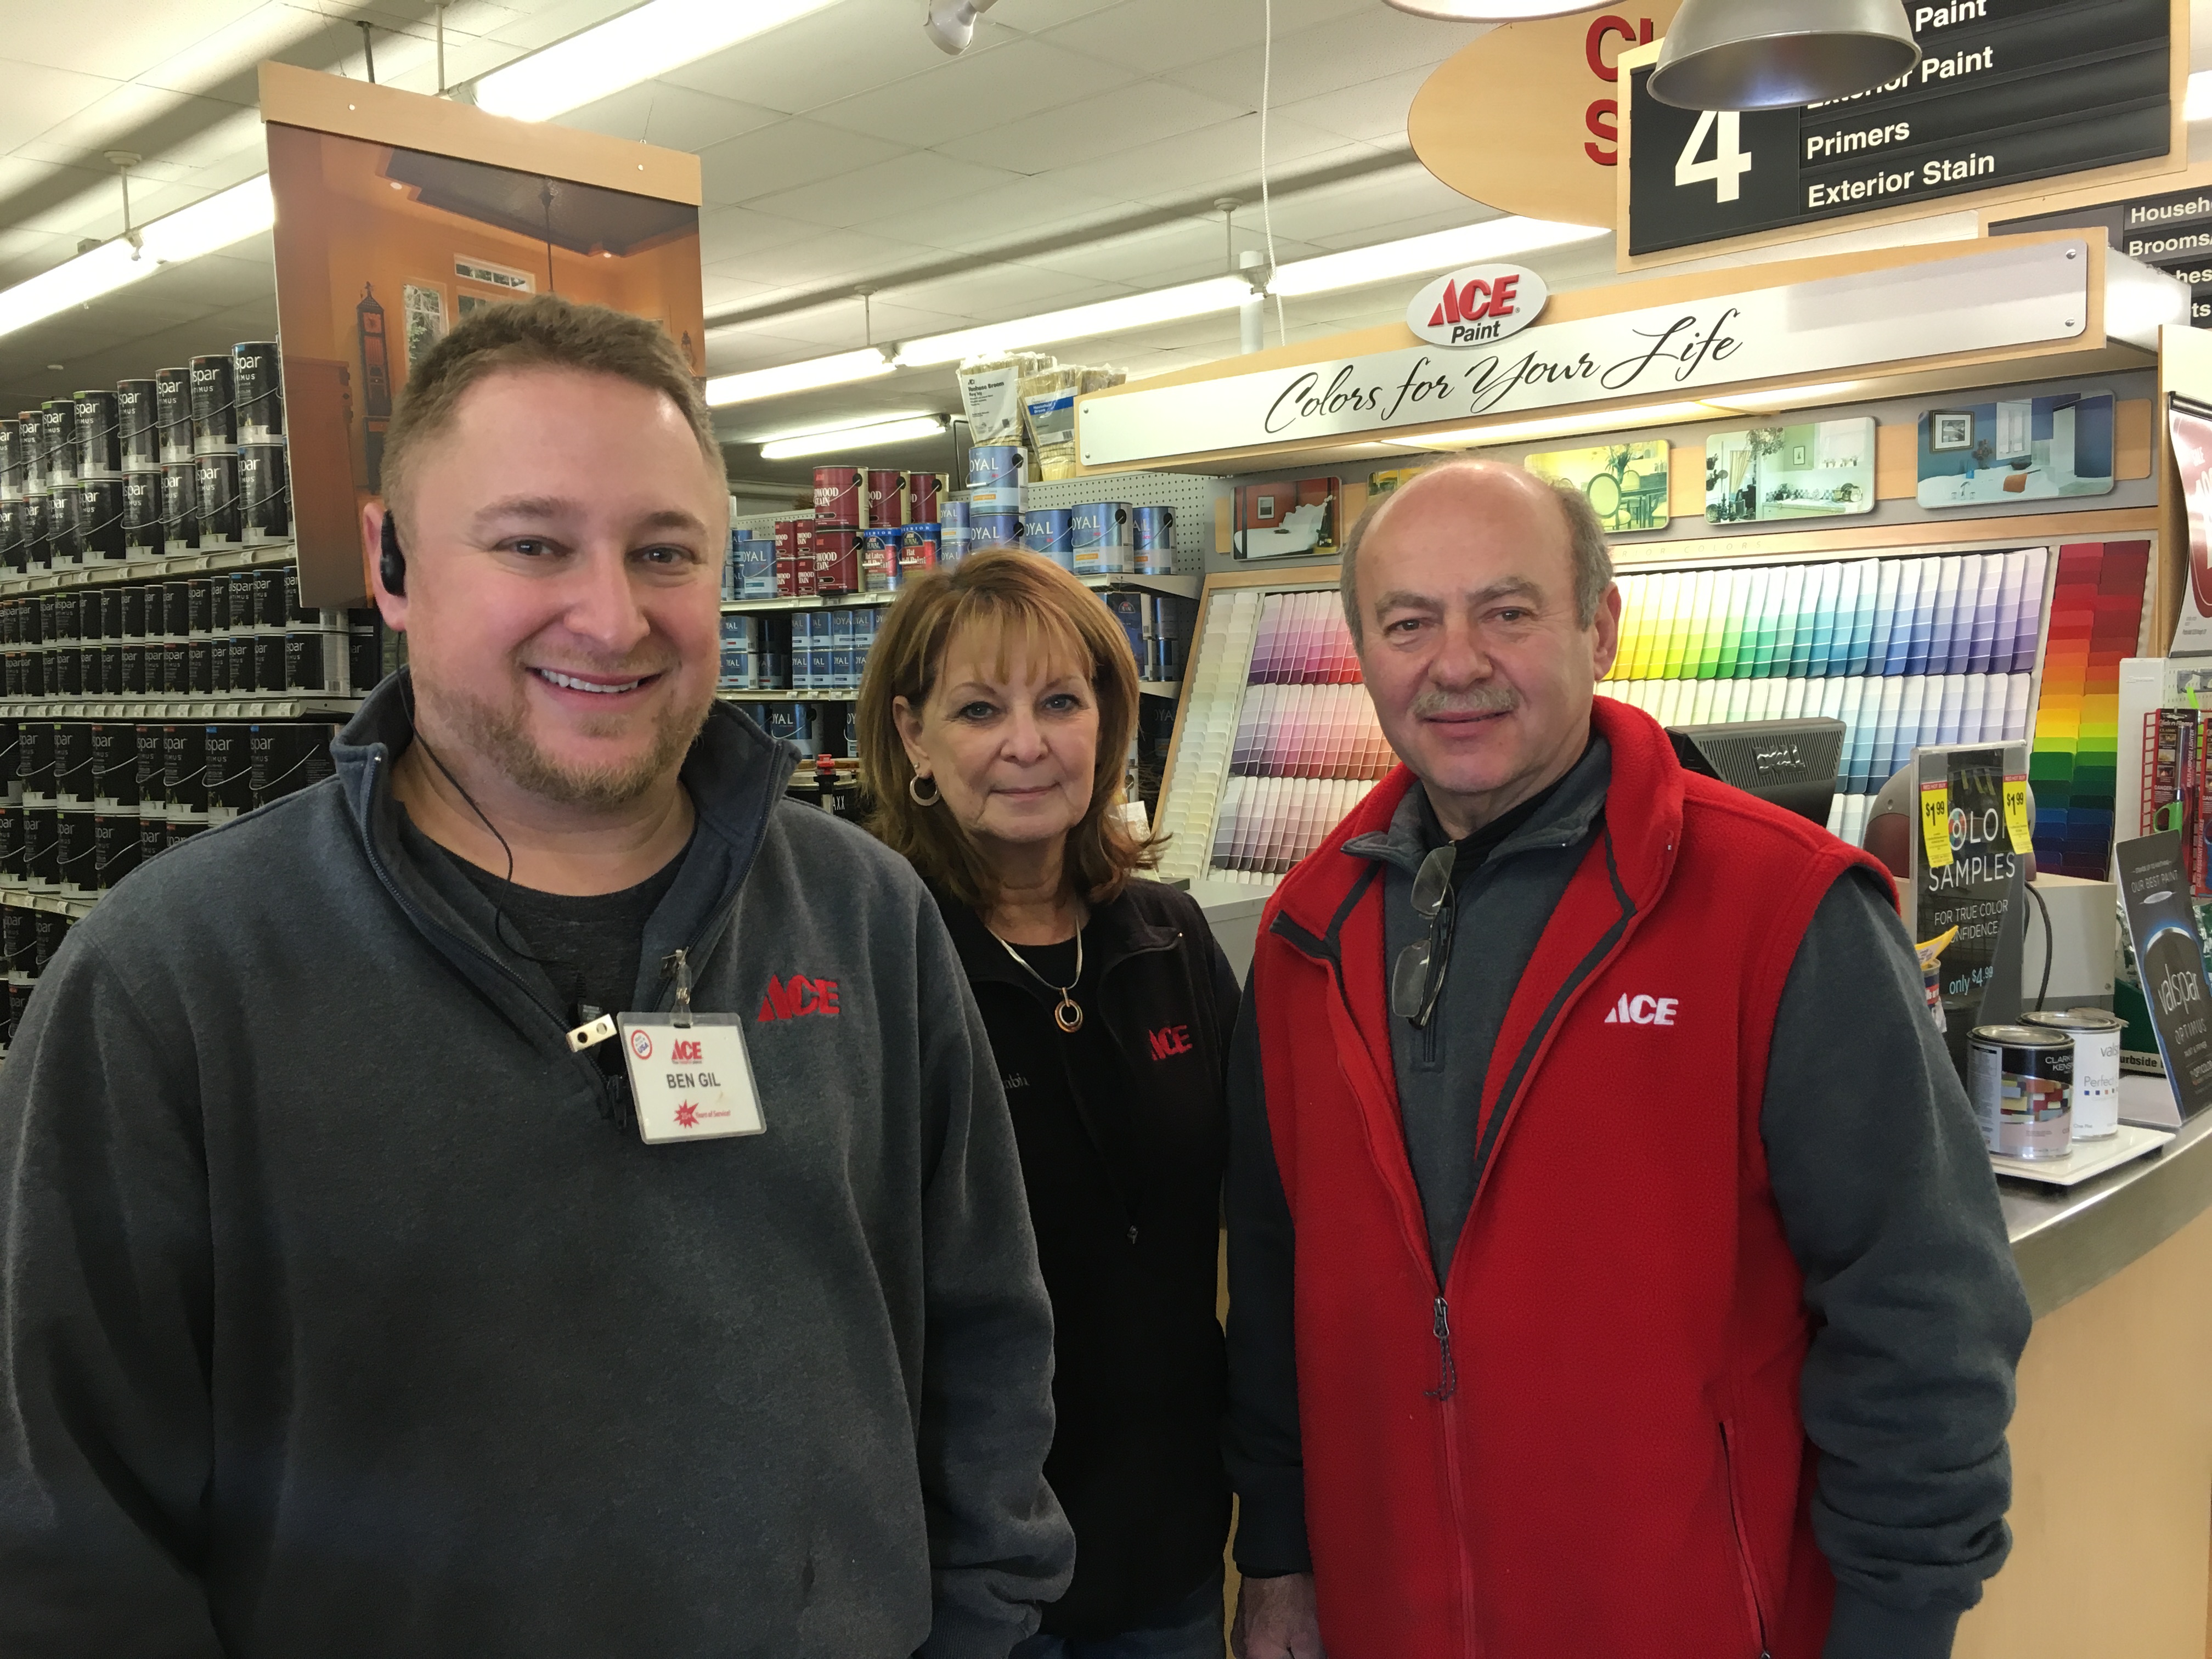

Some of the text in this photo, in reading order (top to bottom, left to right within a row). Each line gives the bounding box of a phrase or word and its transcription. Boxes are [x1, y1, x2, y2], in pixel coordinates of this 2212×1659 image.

[1916, 0, 1986, 31] Paint
[1922, 46, 1993, 82] Paint
[1675, 110, 1751, 202] 4
[1807, 122, 1910, 159] Primers
[1809, 153, 1994, 207] Exterior Stain
[2131, 197, 2212, 223] Househ
[1427, 274, 1519, 326] ACE
[1451, 321, 1500, 343] Paint
[193, 368, 219, 385] spar
[1265, 308, 1742, 433] Colors for Your Life
[1685, 541, 1762, 554] COLORS
[1929, 852, 2015, 891] SAMPLES
[2131, 870, 2178, 893] OUR BEST PAINT
[1934, 899, 2008, 926] FOR TRUE COLOR
[1949, 975, 1970, 996] only
[1972, 966, 1994, 987] $4.99
[2157, 963, 2200, 1015] valspar
[757, 974, 839, 1022] ACE
[1604, 992, 1679, 1025] ACE
[1148, 1025, 1193, 1061] ACE
[2175, 1018, 2207, 1045] OPTIMUS
[672, 1039, 703, 1059] ACE
[667, 1072, 721, 1088] BEN GIL
